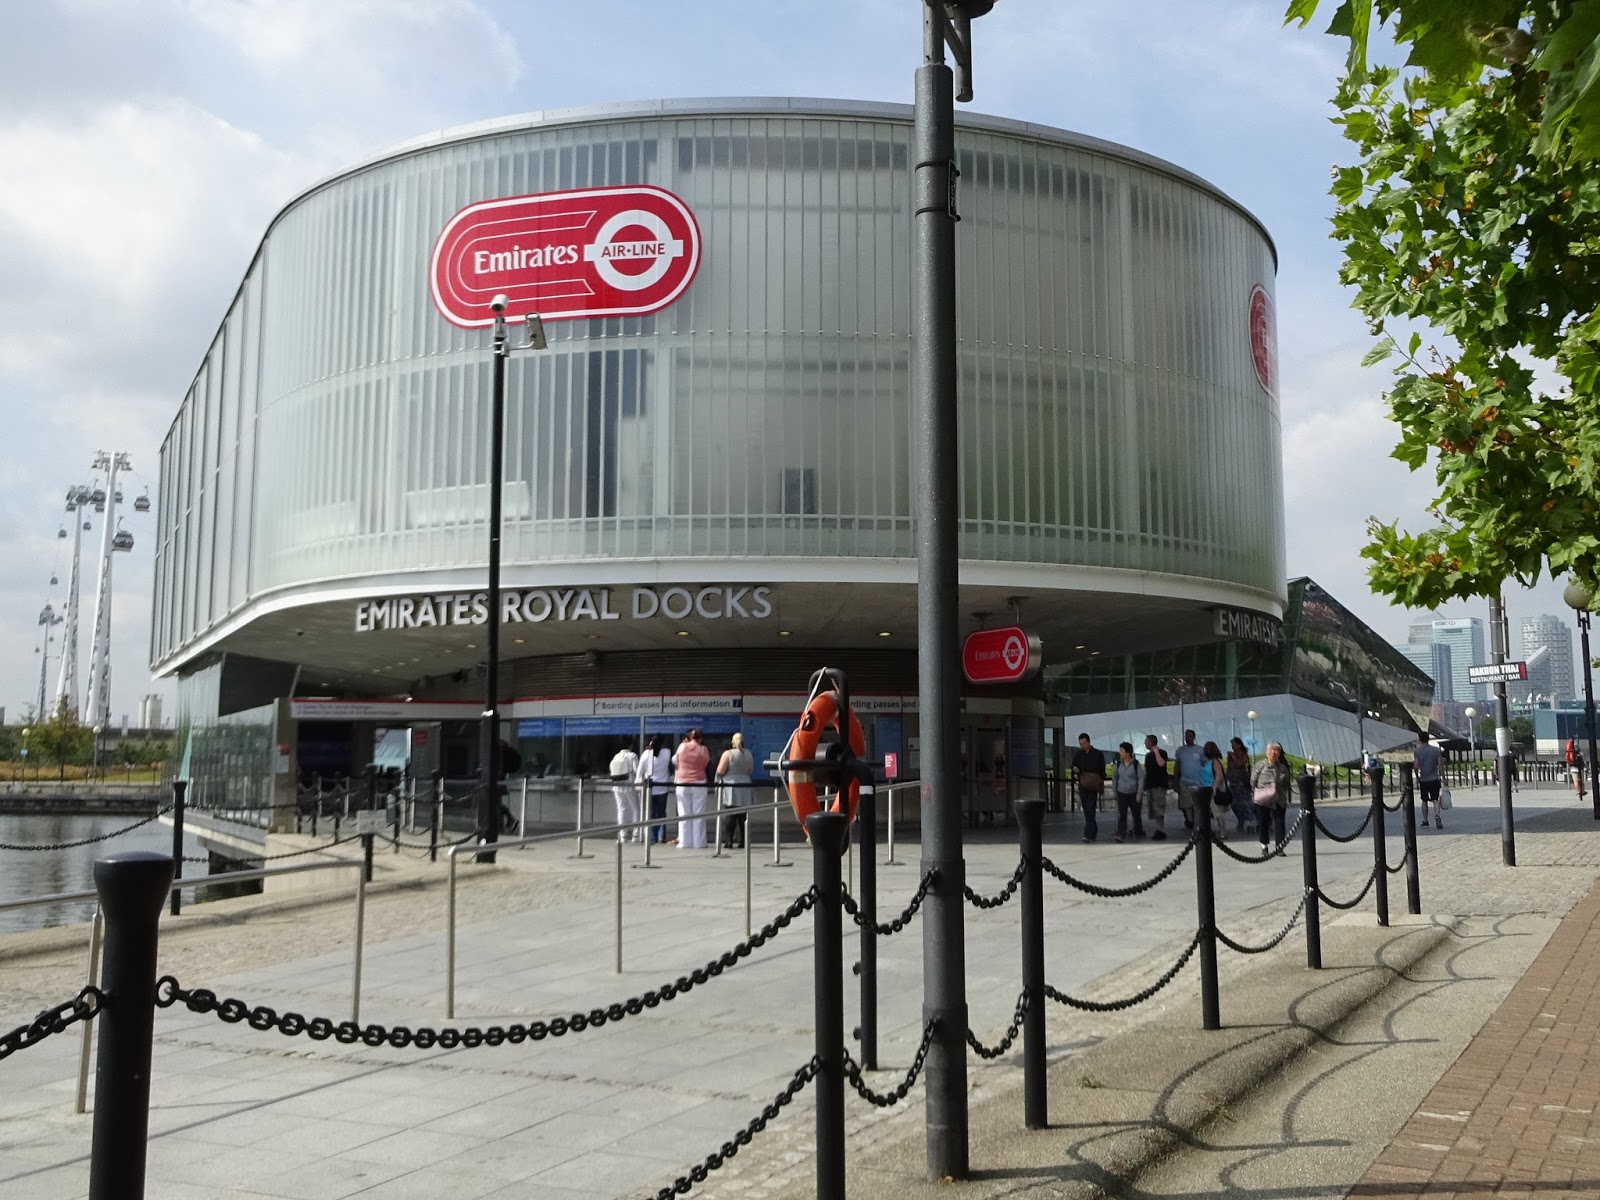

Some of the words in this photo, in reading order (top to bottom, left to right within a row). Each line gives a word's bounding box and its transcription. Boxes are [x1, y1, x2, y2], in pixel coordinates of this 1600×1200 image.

[474, 244, 578, 275] Emirates
[355, 593, 489, 632] EMIRATES
[502, 589, 619, 623] ROYAL
[632, 586, 772, 619] DOCKS
[1469, 665, 1500, 677] NAKHON
[1500, 663, 1519, 674] THAI
[601, 701, 632, 711] Boarding
[634, 701, 660, 710] passes
[663, 700, 678, 708] and
[680, 699, 730, 708] information
[873, 702, 900, 710] passes
[903, 700, 917, 708] and
